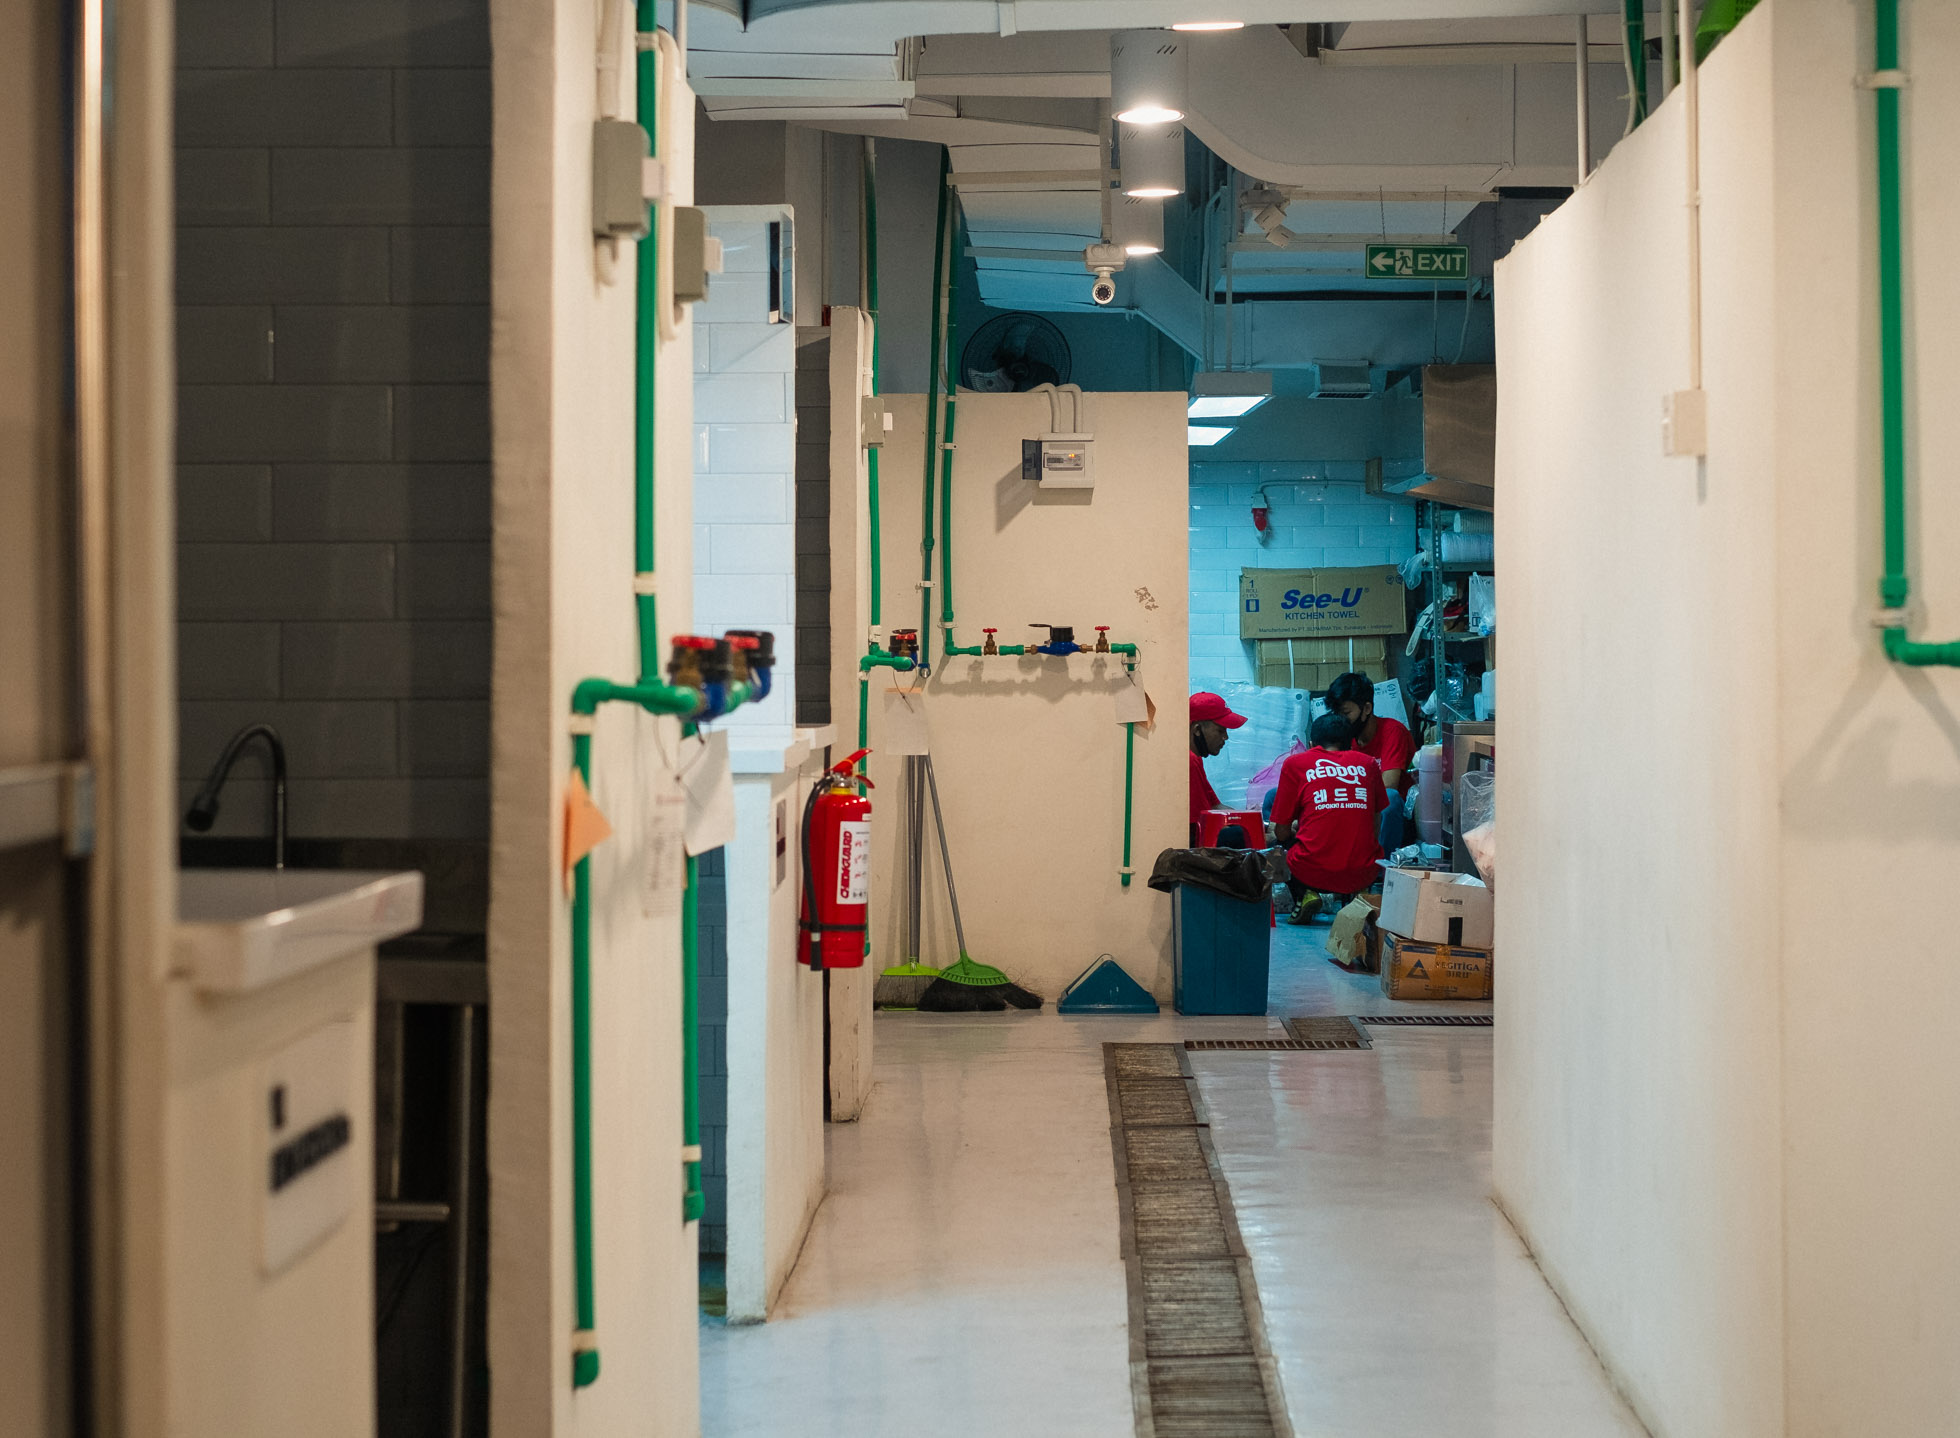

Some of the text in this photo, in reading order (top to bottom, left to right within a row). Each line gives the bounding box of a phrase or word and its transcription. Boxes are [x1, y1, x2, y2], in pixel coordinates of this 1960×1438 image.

[1417, 253, 1465, 271] EXIT
[1249, 579, 1254, 588] 1
[1281, 587, 1363, 610] See-U
[1285, 611, 1360, 620] KITCHEN TOWEL
[1306, 765, 1366, 783] REDDOG
